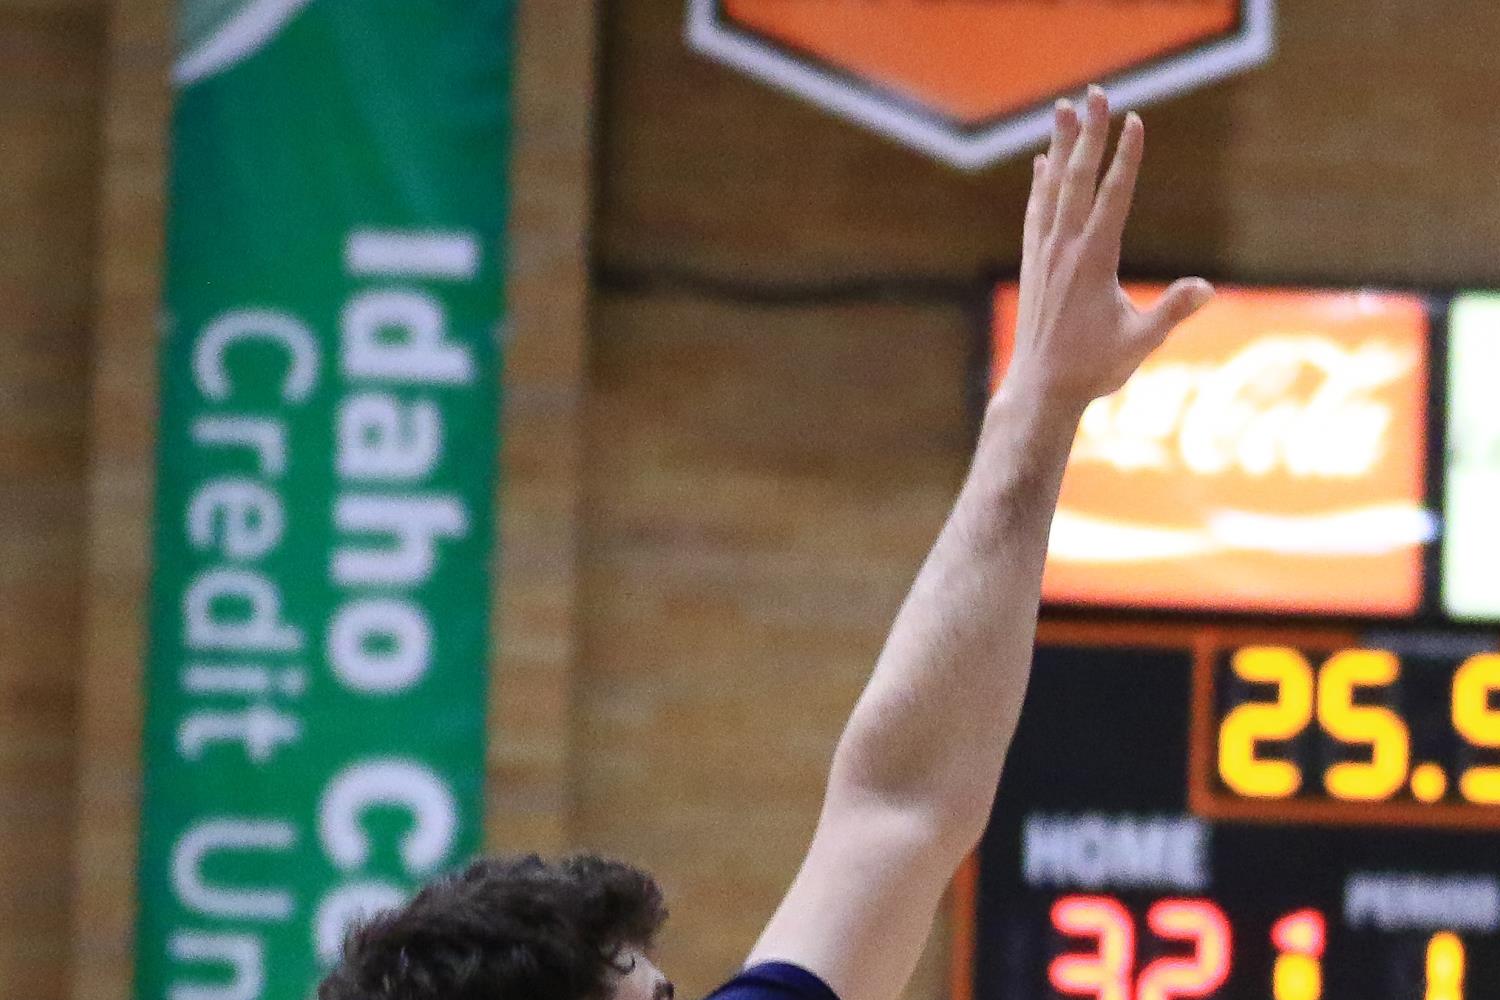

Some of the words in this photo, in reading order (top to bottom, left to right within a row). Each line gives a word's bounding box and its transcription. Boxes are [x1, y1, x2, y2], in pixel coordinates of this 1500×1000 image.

[176, 306, 322, 764] Credit
[326, 228, 482, 694] Idaho
[1022, 810, 1212, 888] HOME
